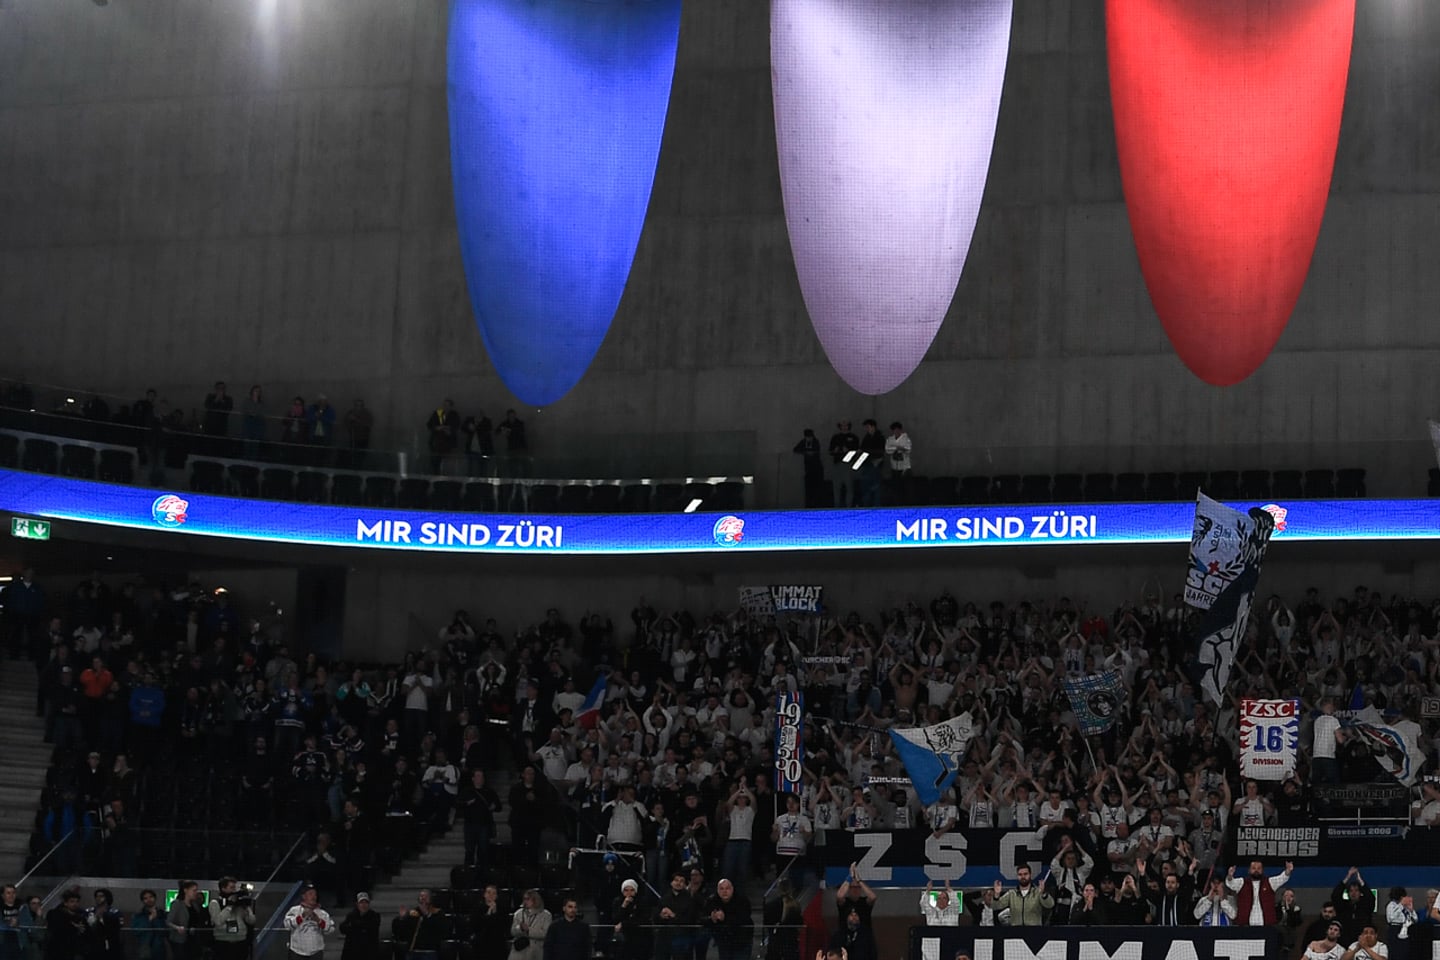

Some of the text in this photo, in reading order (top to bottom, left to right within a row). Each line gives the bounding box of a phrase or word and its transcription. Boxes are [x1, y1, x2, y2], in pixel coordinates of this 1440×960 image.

[356, 519, 562, 548] MIR SIND ZÜRI
[896, 511, 1096, 540] MIR SIND ZÜRI
[772, 586, 822, 600] LIMMAT
[1250, 703, 1291, 717] ZSC
[1253, 726, 1283, 752] 16
